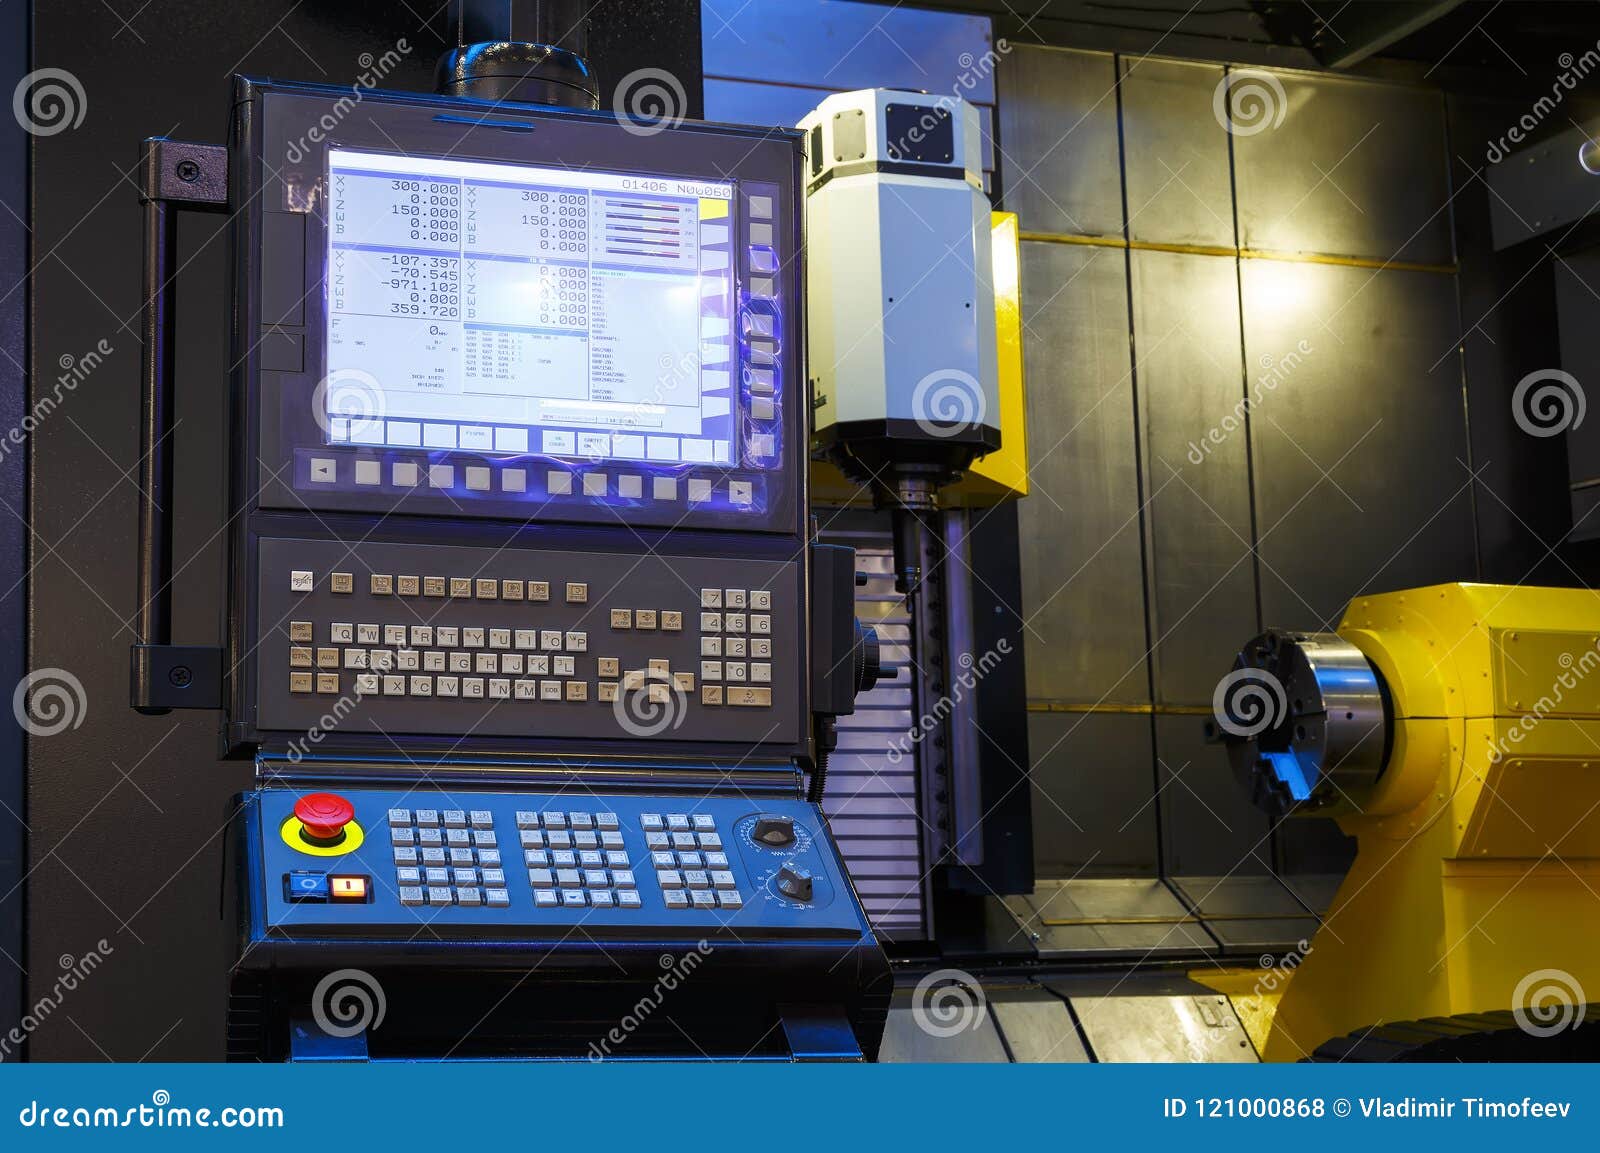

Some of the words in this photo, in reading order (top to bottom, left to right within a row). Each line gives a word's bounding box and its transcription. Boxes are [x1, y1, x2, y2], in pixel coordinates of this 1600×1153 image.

[336, 176, 344, 186] X
[392, 180, 458, 195] 300.000
[336, 188, 344, 196] Y
[410, 194, 458, 207] 0.000
[467, 186, 476, 196] X
[522, 192, 586, 206] 300.000
[336, 200, 344, 210] Z
[392, 205, 458, 218] 150.000
[467, 199, 476, 208] Y
[540, 205, 586, 217] 0.000
[336, 212, 344, 221] W
[410, 218, 458, 230] 0.000
[467, 211, 476, 220] Z
[522, 215, 586, 229] 150.000
[336, 224, 344, 234] B
[410, 230, 458, 242] 0.000
[467, 223, 476, 232] W
[540, 229, 586, 241] 0.000
[468, 235, 476, 244] B
[540, 241, 586, 252] 0.000
[336, 251, 344, 260] X
[381, 255, 458, 268] -107.397
[336, 262, 344, 272] Y
[392, 268, 458, 281] -70.545
[467, 261, 476, 270] X
[540, 266, 586, 278] 0.000
[467, 273, 476, 282] Y
[336, 274, 344, 284] Z
[381, 280, 458, 293] -971.102
[467, 285, 476, 294] Z
[335, 288, 344, 296] W
[410, 293, 458, 305] 0.000
[336, 300, 344, 308] B
[391, 304, 458, 317] 359.720
[467, 297, 476, 305] W
[540, 302, 586, 314] 0.000
[468, 309, 476, 318] B
[540, 314, 586, 325] 0.000
[332, 319, 340, 328] F
[711, 594, 719, 603] 7
[735, 595, 743, 603] 8
[760, 597, 767, 605] 9
[710, 618, 718, 627] 4
[735, 619, 743, 627] 5
[760, 621, 767, 629] 6
[341, 630, 351, 640] Q
[366, 631, 377, 640] W
[394, 631, 402, 640] E
[421, 632, 429, 641] R
[448, 634, 455, 643] T
[473, 634, 482, 644] Y
[500, 635, 508, 645] U
[577, 638, 585, 648] P
[712, 643, 716, 651] 1
[735, 644, 743, 653] 2
[760, 644, 768, 653] 3
[354, 656, 363, 665] A
[381, 656, 390, 666] S
[408, 657, 416, 666] D
[435, 658, 442, 667] F
[459, 659, 469, 669] G
[486, 660, 495, 669] H
[512, 661, 520, 670] J
[538, 662, 546, 671] K
[564, 663, 572, 672] L
[368, 680, 376, 689] Z
[393, 682, 401, 690] X
[420, 683, 429, 692] C
[447, 683, 456, 692] V
[473, 685, 481, 694] B
[500, 685, 508, 695] N
[525, 686, 534, 696] M
